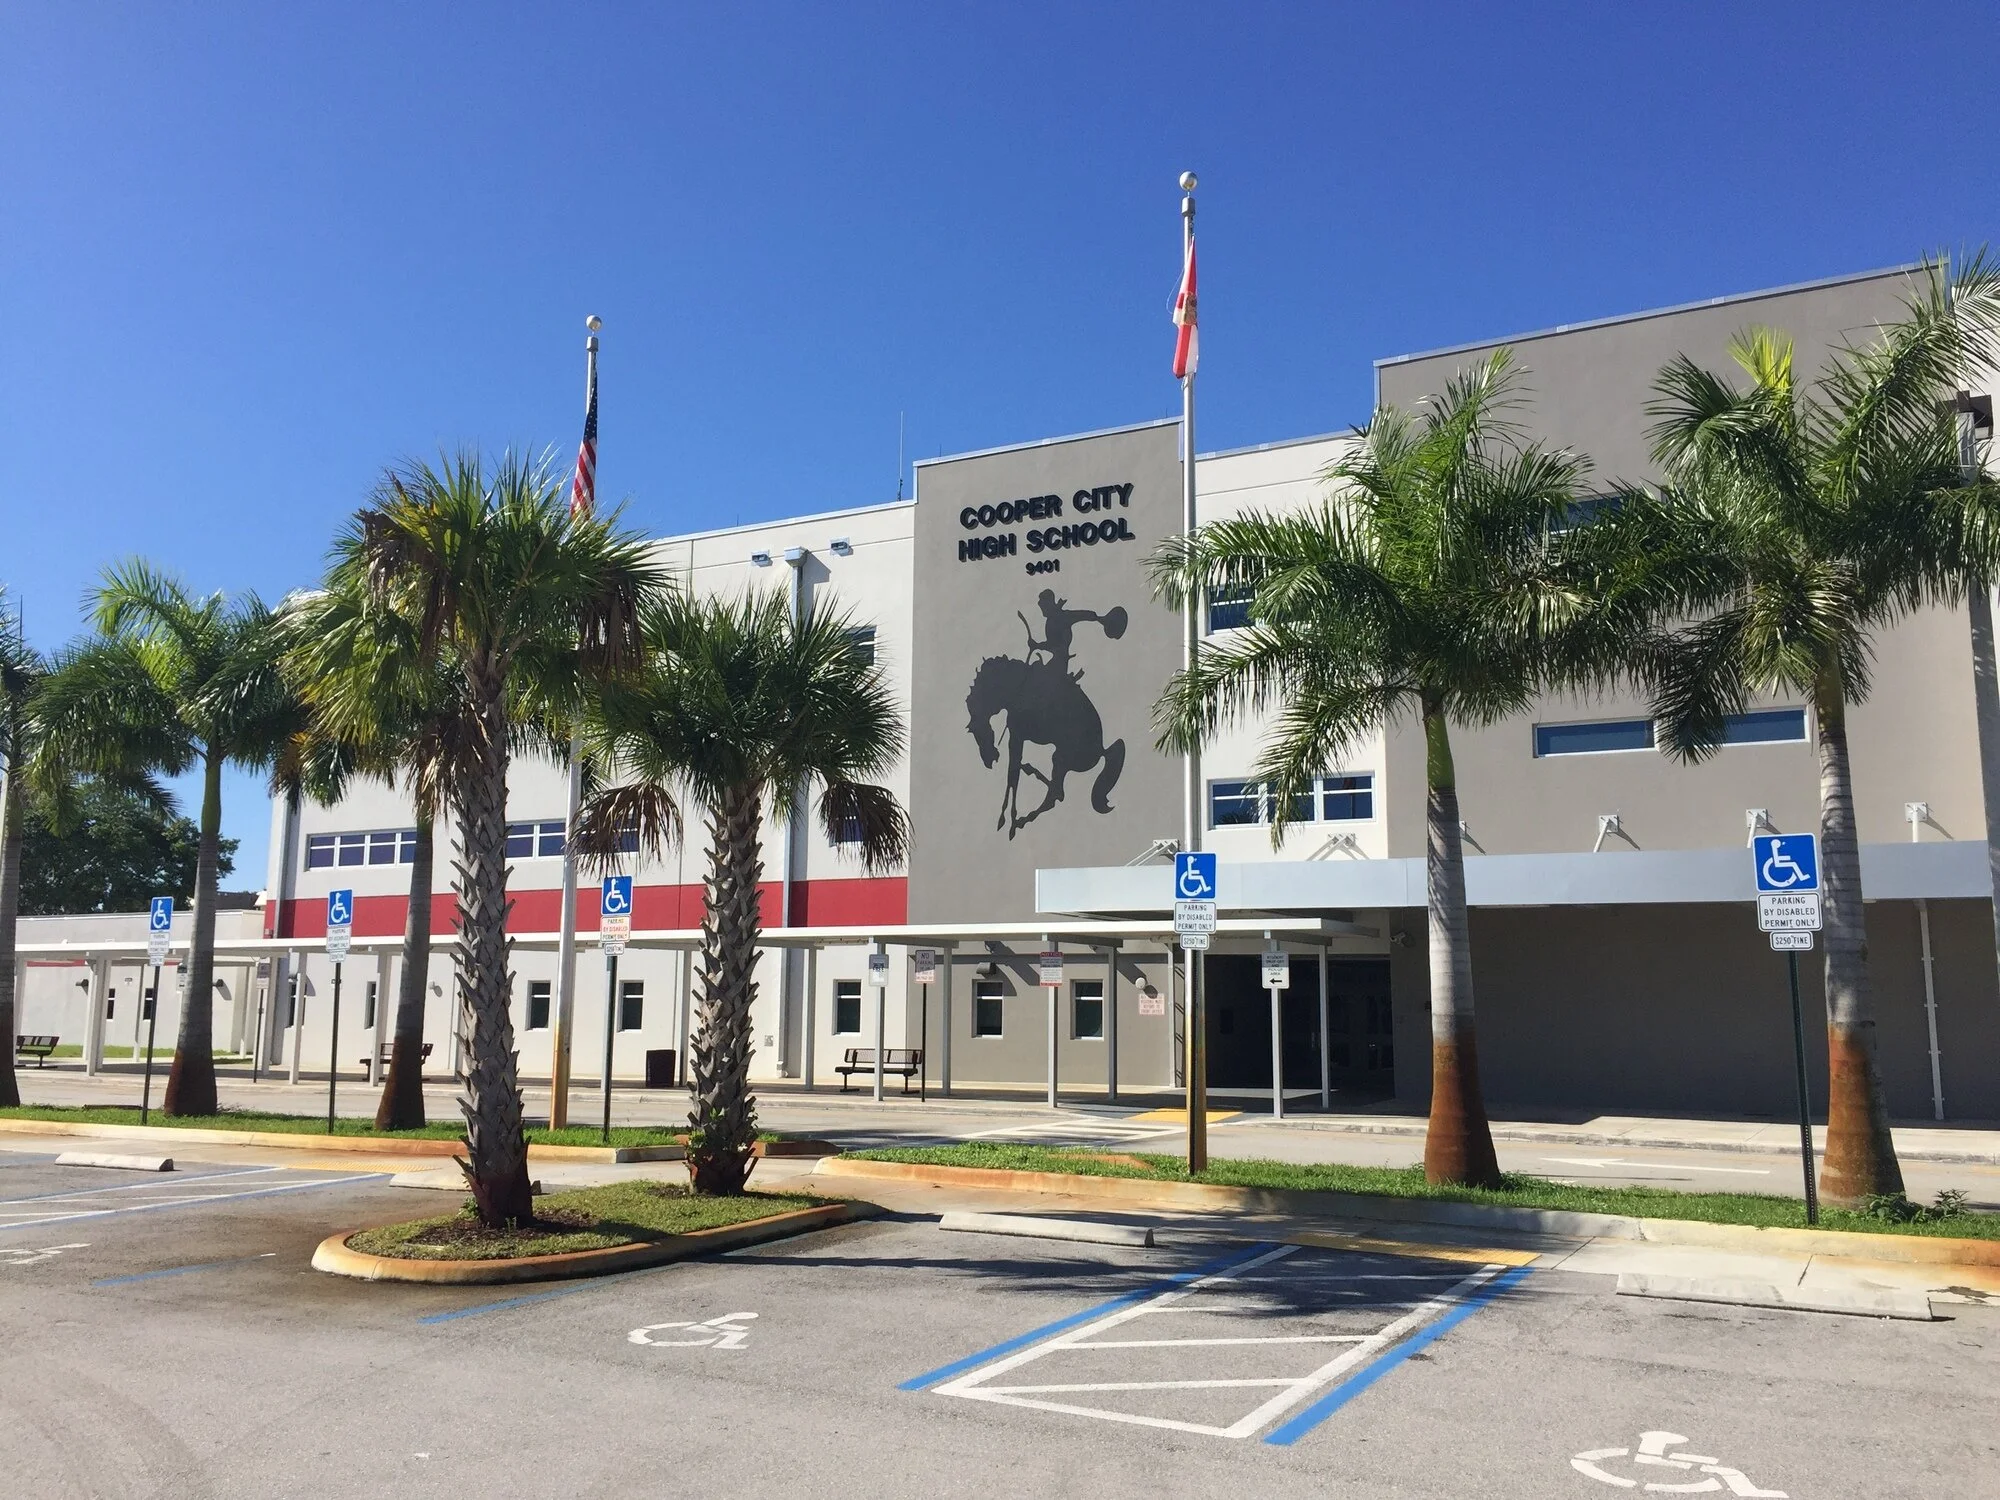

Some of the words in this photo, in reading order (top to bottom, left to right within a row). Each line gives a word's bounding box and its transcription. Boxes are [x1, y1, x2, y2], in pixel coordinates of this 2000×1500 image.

[960, 494, 1063, 530] COOPER
[1073, 482, 1134, 513] CITY
[958, 532, 1017, 562] HIGH
[1026, 517, 1135, 553] SCHOOL
[1025, 558, 1060, 576] 9401
[1771, 896, 1806, 905] PARKING
[1763, 908, 1775, 917] BY
[1776, 907, 1816, 916] DISABLED
[1764, 919, 1793, 928] PERMIT
[1795, 918, 1816, 927] ONLY
[1775, 936, 1792, 945] $250
[1793, 936, 1808, 945] FINE
[921, 952, 930, 960] NO
